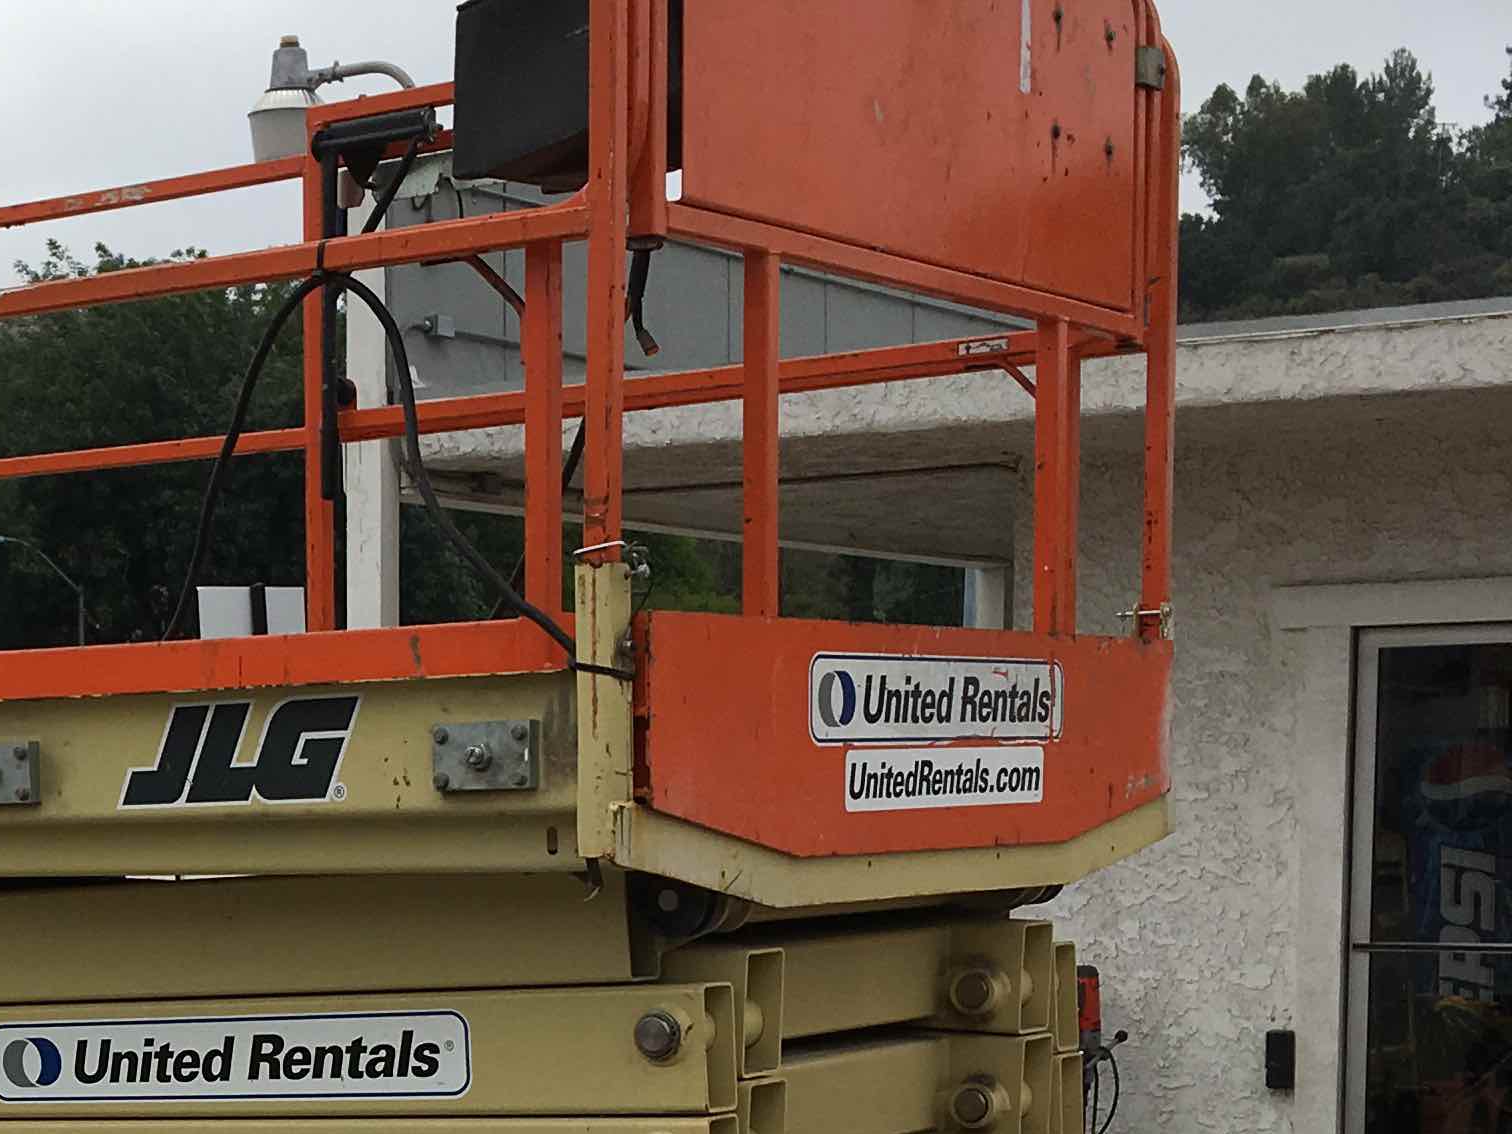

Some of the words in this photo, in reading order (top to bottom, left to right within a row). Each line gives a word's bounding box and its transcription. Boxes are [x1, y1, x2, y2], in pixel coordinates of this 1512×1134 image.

[863, 674, 955, 724] United
[960, 676, 1051, 724] Rentals
[120, 695, 361, 808] JLG
[849, 758, 1041, 800] UnitedRentals.com
[1439, 845, 1496, 1001] PSI
[74, 1036, 235, 1084] United
[247, 1030, 440, 1080] Rentals
